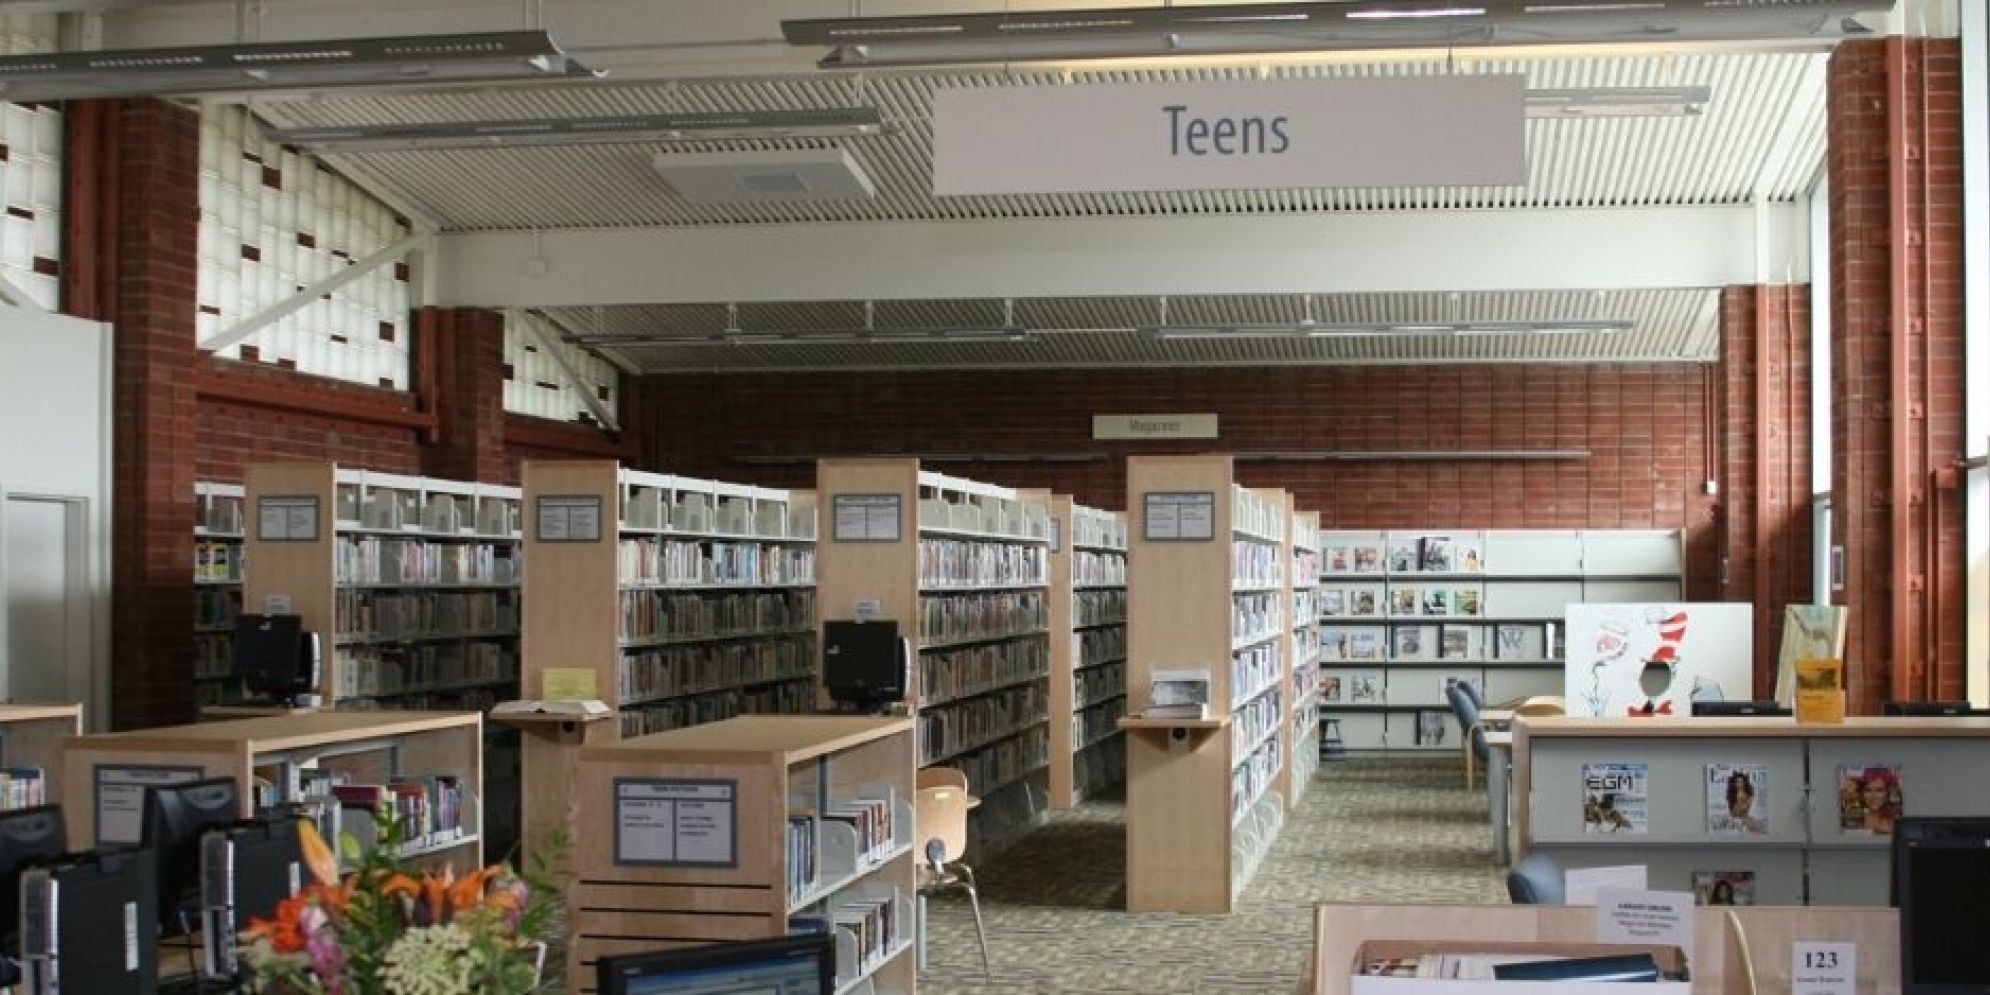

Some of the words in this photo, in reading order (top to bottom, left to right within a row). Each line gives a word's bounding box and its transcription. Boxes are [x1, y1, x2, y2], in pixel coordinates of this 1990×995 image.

[1162, 105, 1290, 155] Teens
[1586, 775, 1634, 791] EGM
[1804, 951, 1838, 968] 123
